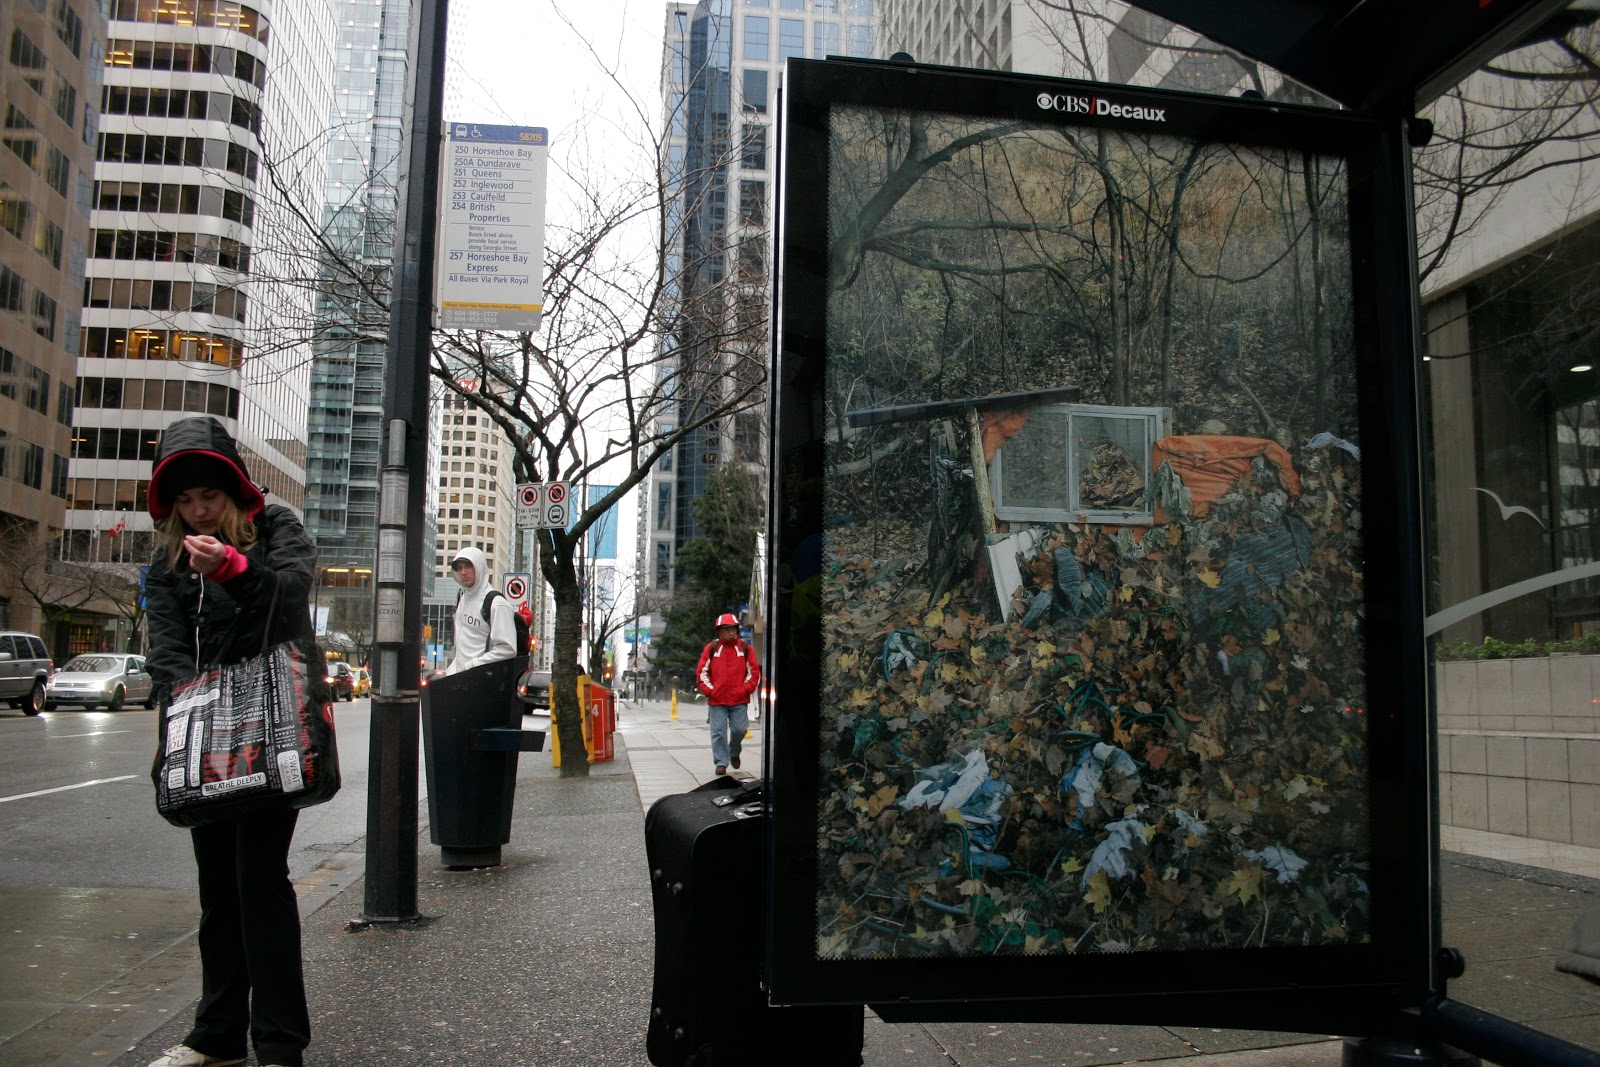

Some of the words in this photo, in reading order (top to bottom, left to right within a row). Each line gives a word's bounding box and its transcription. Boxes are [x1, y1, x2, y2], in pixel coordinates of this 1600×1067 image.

[520, 132, 542, 142] 58705
[472, 147, 514, 156] Horseshoe
[517, 149, 532, 158] Bay
[477, 160, 520, 168] Dundarave
[472, 169, 502, 178] Queens
[471, 181, 513, 190] Inglewood
[470, 193, 505, 201] Caulfeild
[470, 203, 495, 211] British
[469, 213, 510, 223] Properties
[468, 252, 509, 262] Horseshoe
[513, 254, 528, 264] Bay
[467, 263, 498, 272] Express
[510, 277, 528, 285] Royal
[592, 704, 599, 716] 4
[289, 755, 300, 783] SWEAT
[205, 780, 236, 792] BREATHE
[237, 774, 262, 786] DEEPLY
